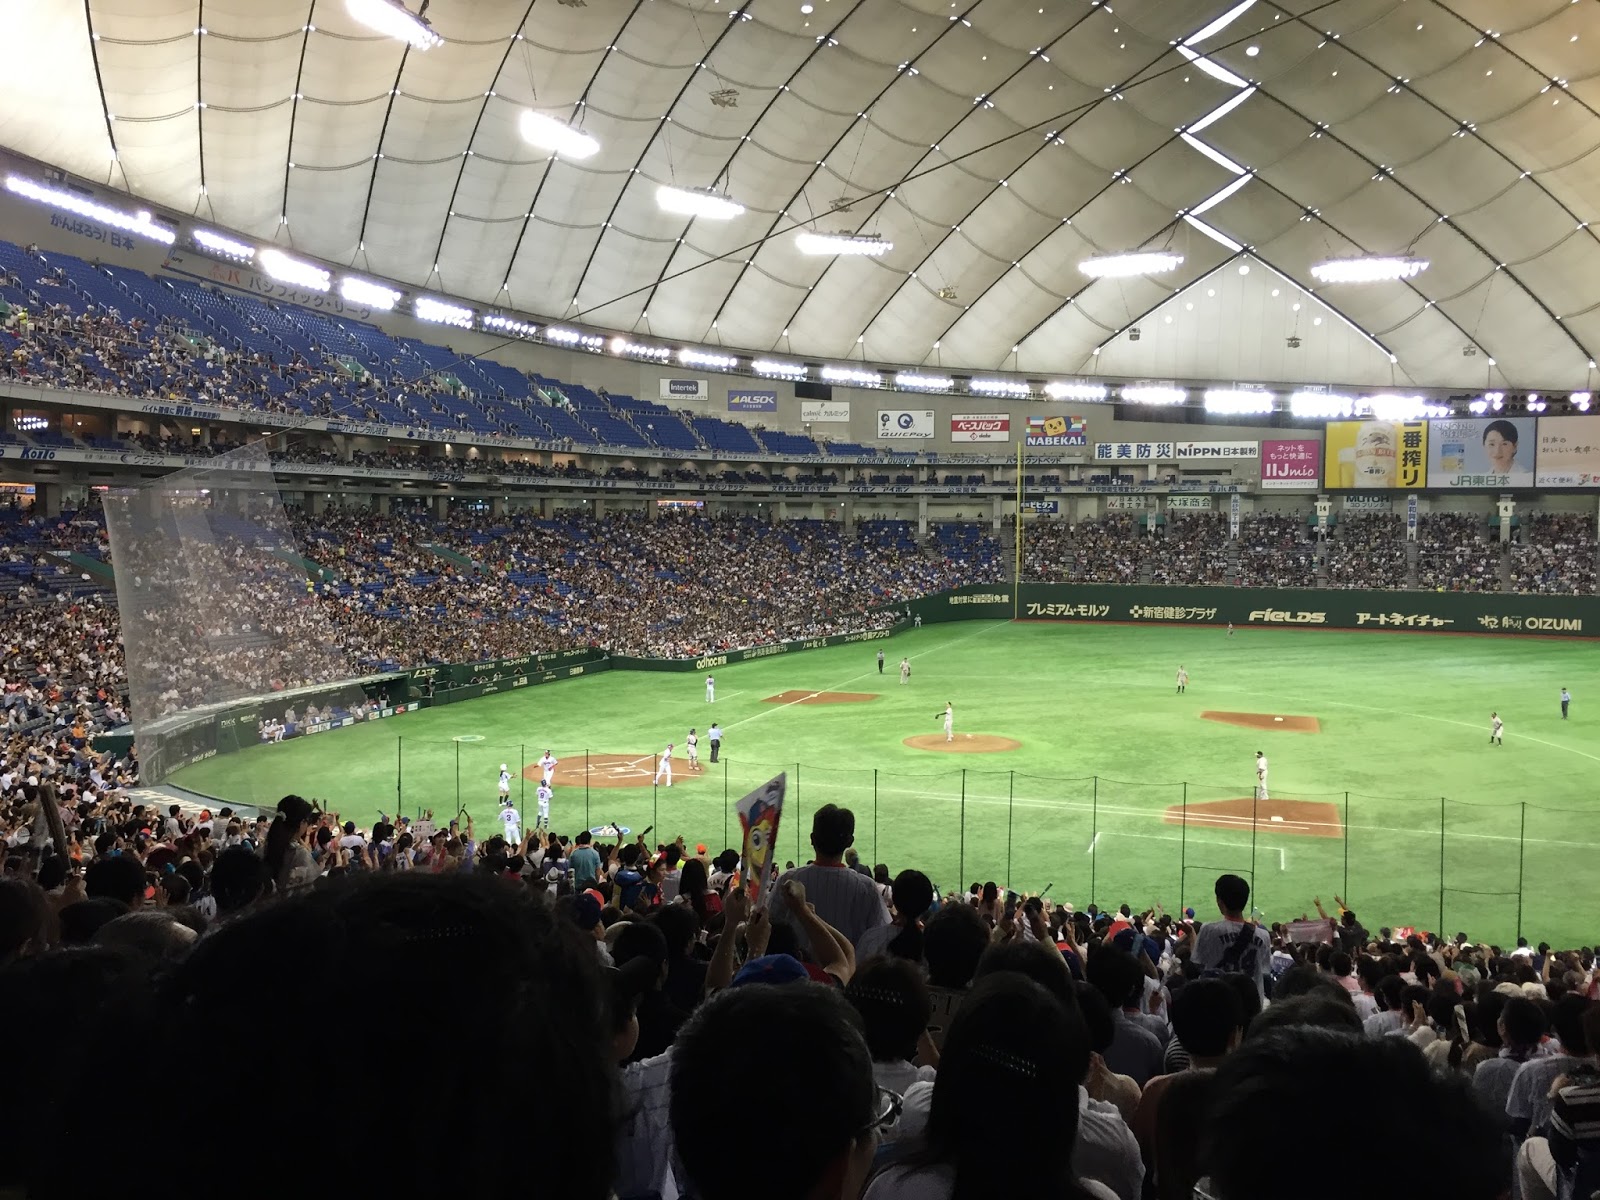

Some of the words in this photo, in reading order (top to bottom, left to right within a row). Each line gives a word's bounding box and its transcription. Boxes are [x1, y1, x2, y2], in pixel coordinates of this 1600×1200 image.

[671, 384, 697, 392] Intertek
[740, 396, 774, 404] ALSOK
[1542, 436, 1567, 444] 日本の
[1097, 443, 1172, 459] 能美防災
[1223, 447, 1257, 456] 日本製粉
[1277, 444, 1305, 452] ネットを
[1402, 422, 1423, 486] 一番搾り
[1450, 475, 1510, 487] JR東日本
[1168, 498, 1210, 507] 大塚商会
[1026, 603, 1110, 617] プレミアム・モルツ
[1143, 606, 1218, 620] 新宿健診プラザ
[1356, 612, 1455, 627] アートネイチャー
[1525, 617, 1582, 631] OIZUMI
[696, 657, 717, 669] adhoc
